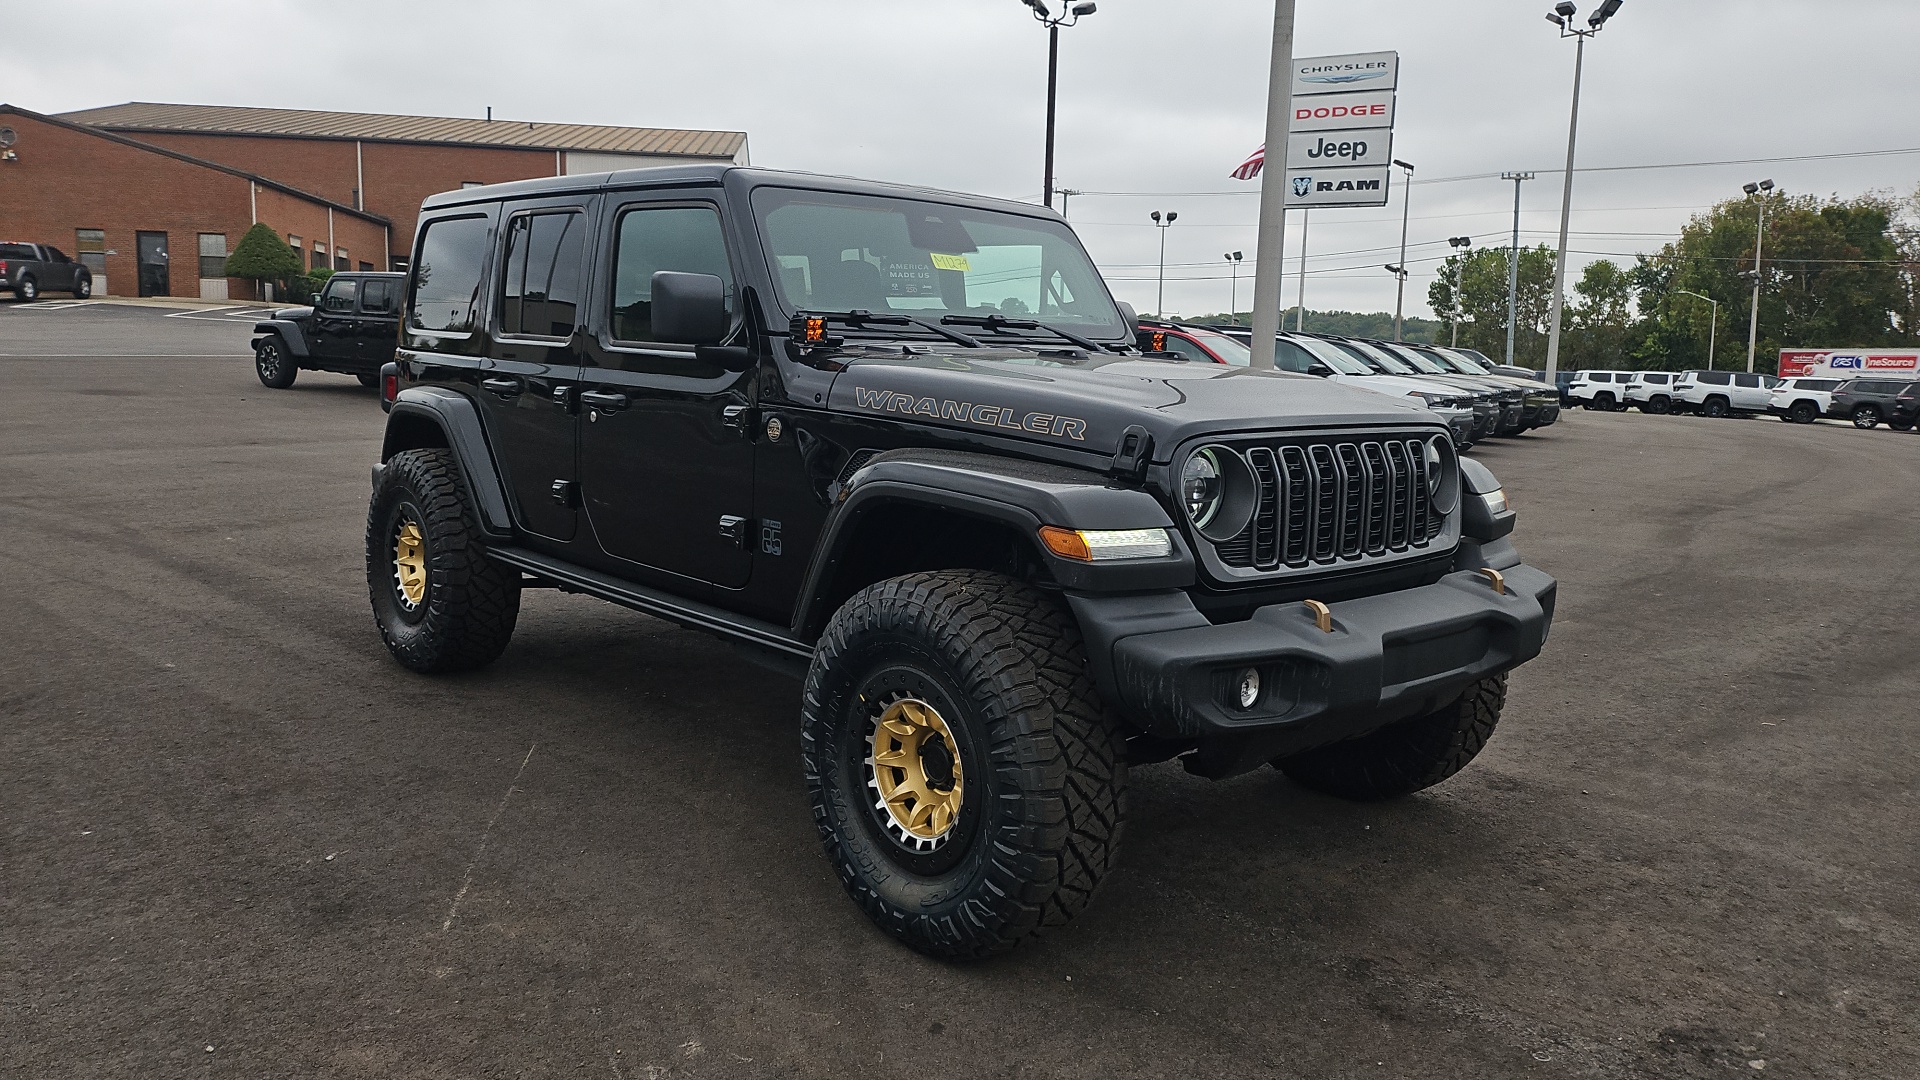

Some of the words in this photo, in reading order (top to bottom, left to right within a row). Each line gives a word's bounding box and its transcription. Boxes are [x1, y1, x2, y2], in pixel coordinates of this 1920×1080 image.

[1301, 62, 1387, 74] CHRYSLER
[1296, 104, 1386, 120] DODGE
[1307, 138, 1368, 161] Jeep
[1316, 180, 1380, 192] RAM
[889, 271, 915, 279] MADE
[855, 386, 1087, 441] WRANGLER
